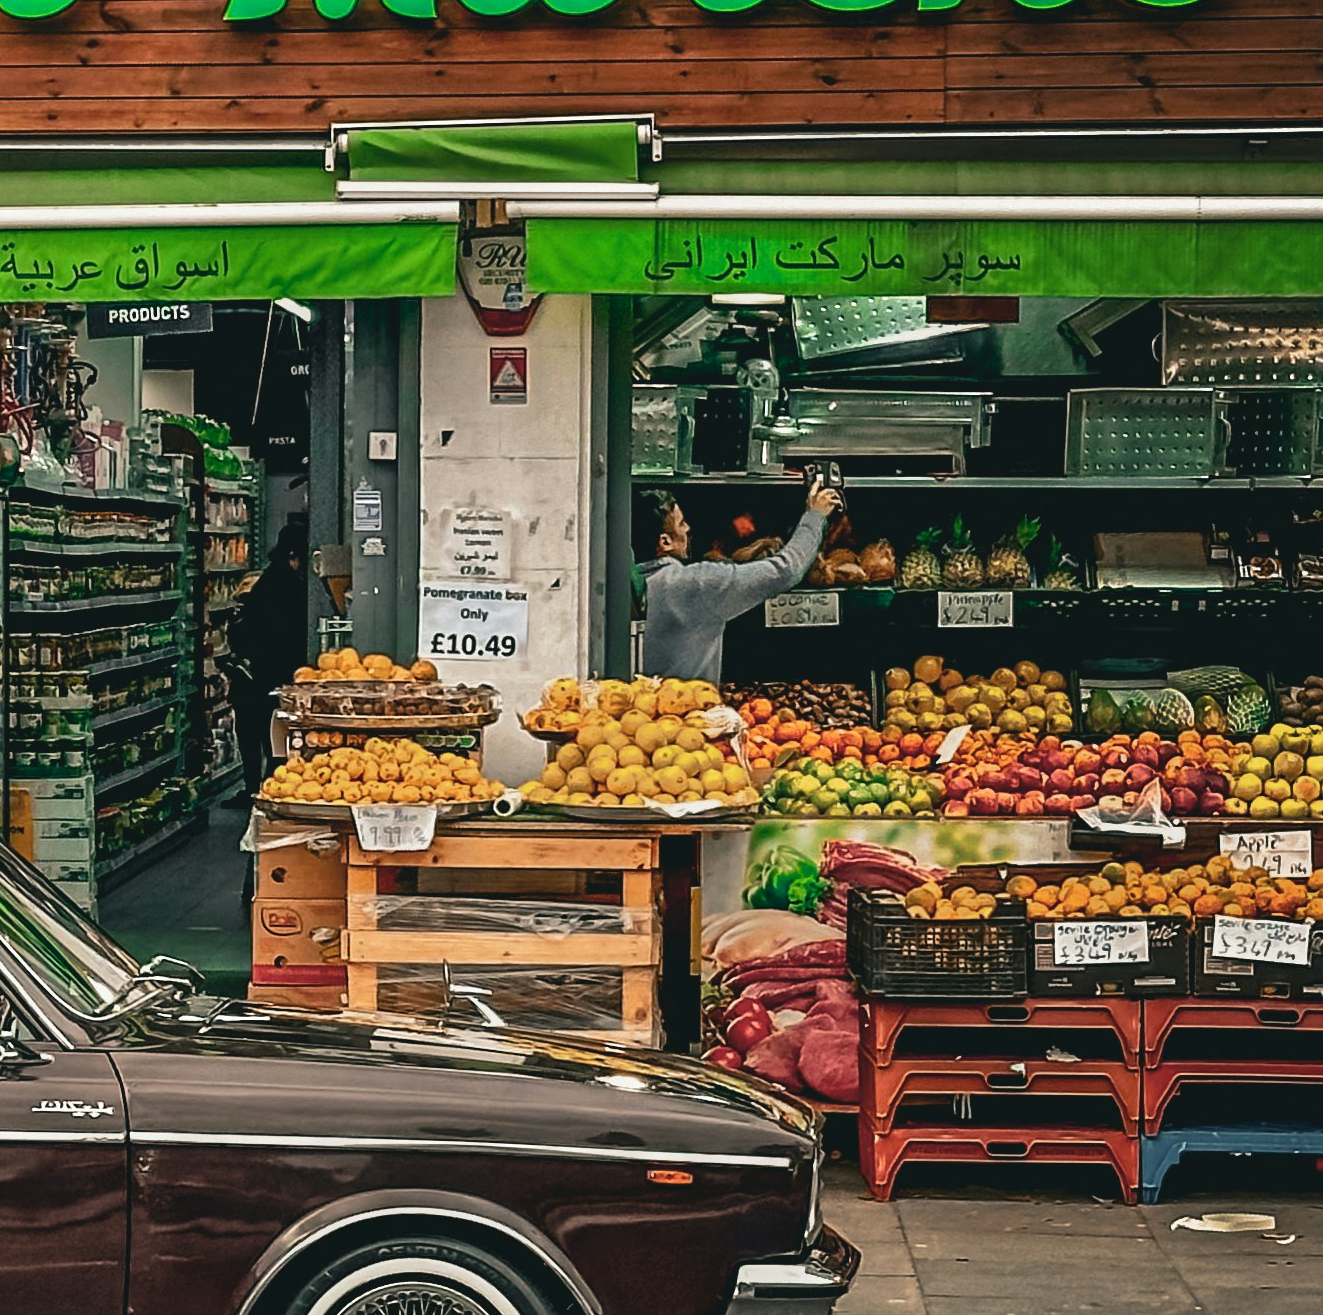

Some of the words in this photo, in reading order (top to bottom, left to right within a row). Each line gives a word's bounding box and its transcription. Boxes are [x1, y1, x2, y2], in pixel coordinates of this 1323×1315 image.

[0, 241, 104, 293] عربية
[108, 304, 191, 324] PRODUCTS
[423, 586, 503, 601] Pomegranate
[505, 589, 528, 601] box
[460, 608, 489, 622] Only
[430, 632, 516, 657] £10.49
[1237, 834, 1280, 852] Apple
